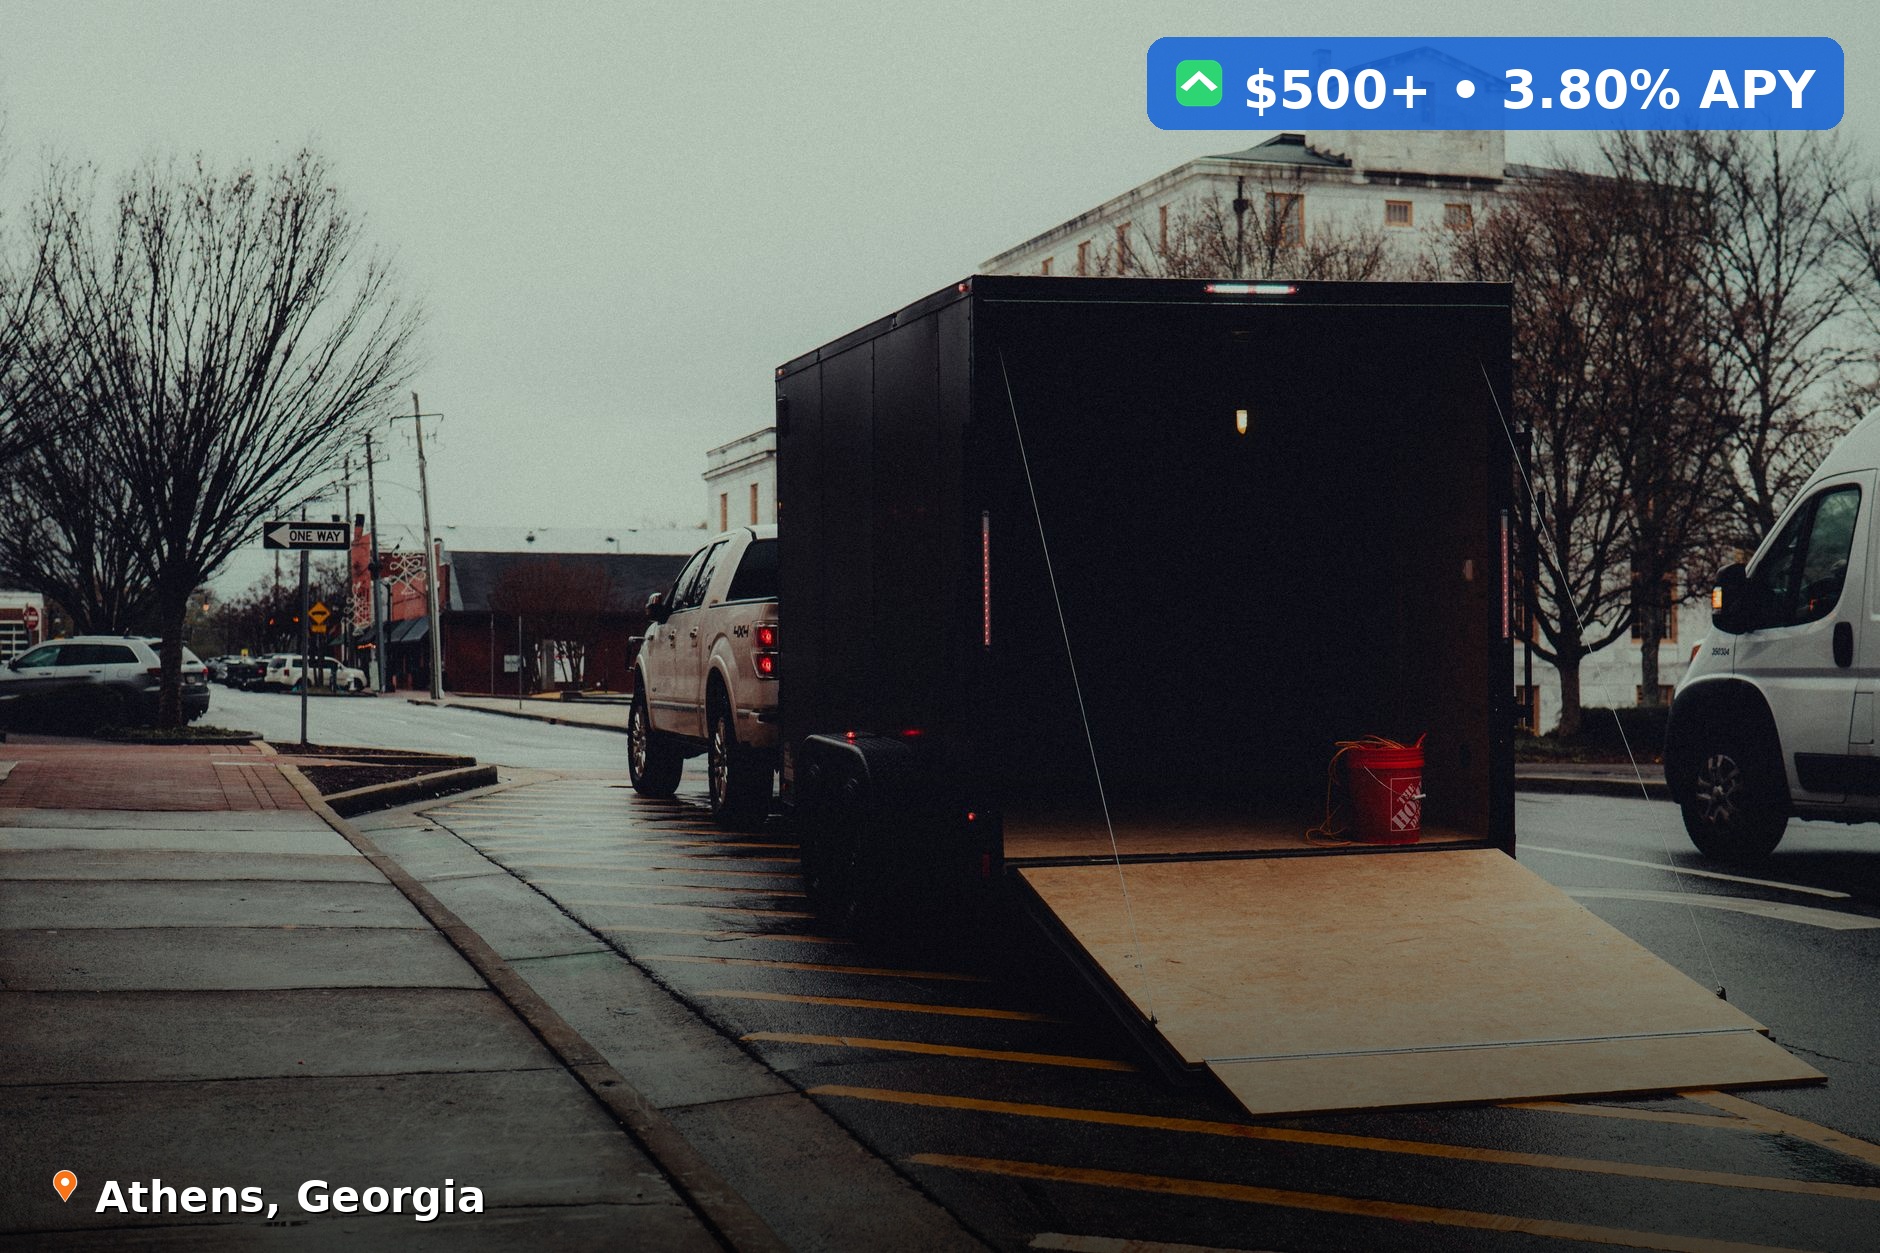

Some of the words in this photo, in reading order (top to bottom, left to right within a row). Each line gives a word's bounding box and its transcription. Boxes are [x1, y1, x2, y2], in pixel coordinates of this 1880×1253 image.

[290, 530, 313, 542] ONE
[316, 530, 341, 542] WAY
[1396, 783, 1416, 805] THE
